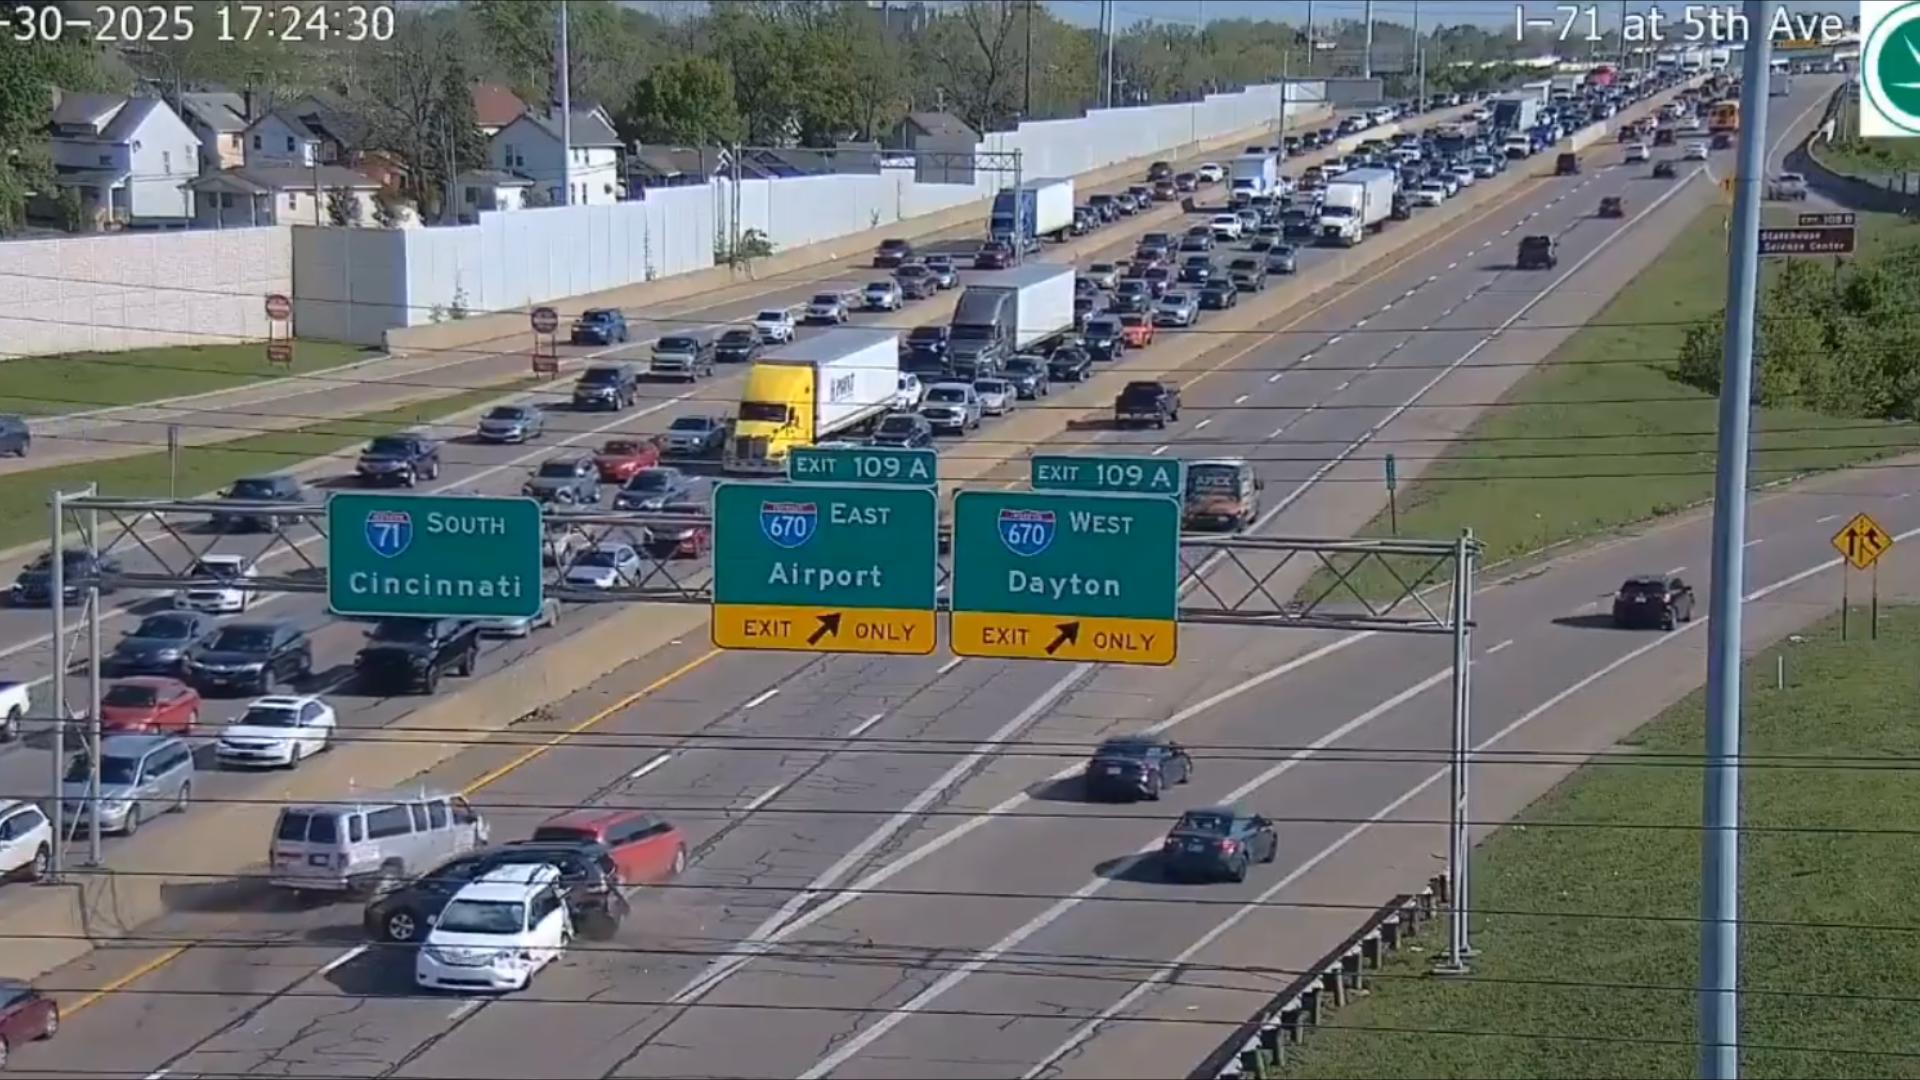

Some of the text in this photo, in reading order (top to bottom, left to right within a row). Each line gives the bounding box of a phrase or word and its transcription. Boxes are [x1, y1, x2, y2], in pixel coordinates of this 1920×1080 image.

[1764, 241, 1845, 251] Science Center
[796, 456, 929, 479] EXIT 109 A
[1038, 464, 1171, 488] EXIT 109 A
[373, 511, 505, 548] 71 SOUTH
[770, 502, 891, 537] 670 EAST
[1007, 511, 1134, 545] 670 WEST
[350, 571, 521, 598] Cincinnati
[767, 562, 882, 591] Airport
[1008, 570, 1120, 600] Dayton
[744, 620, 916, 642] EXIT ONLY
[982, 627, 1156, 651] EXIT ONLY
